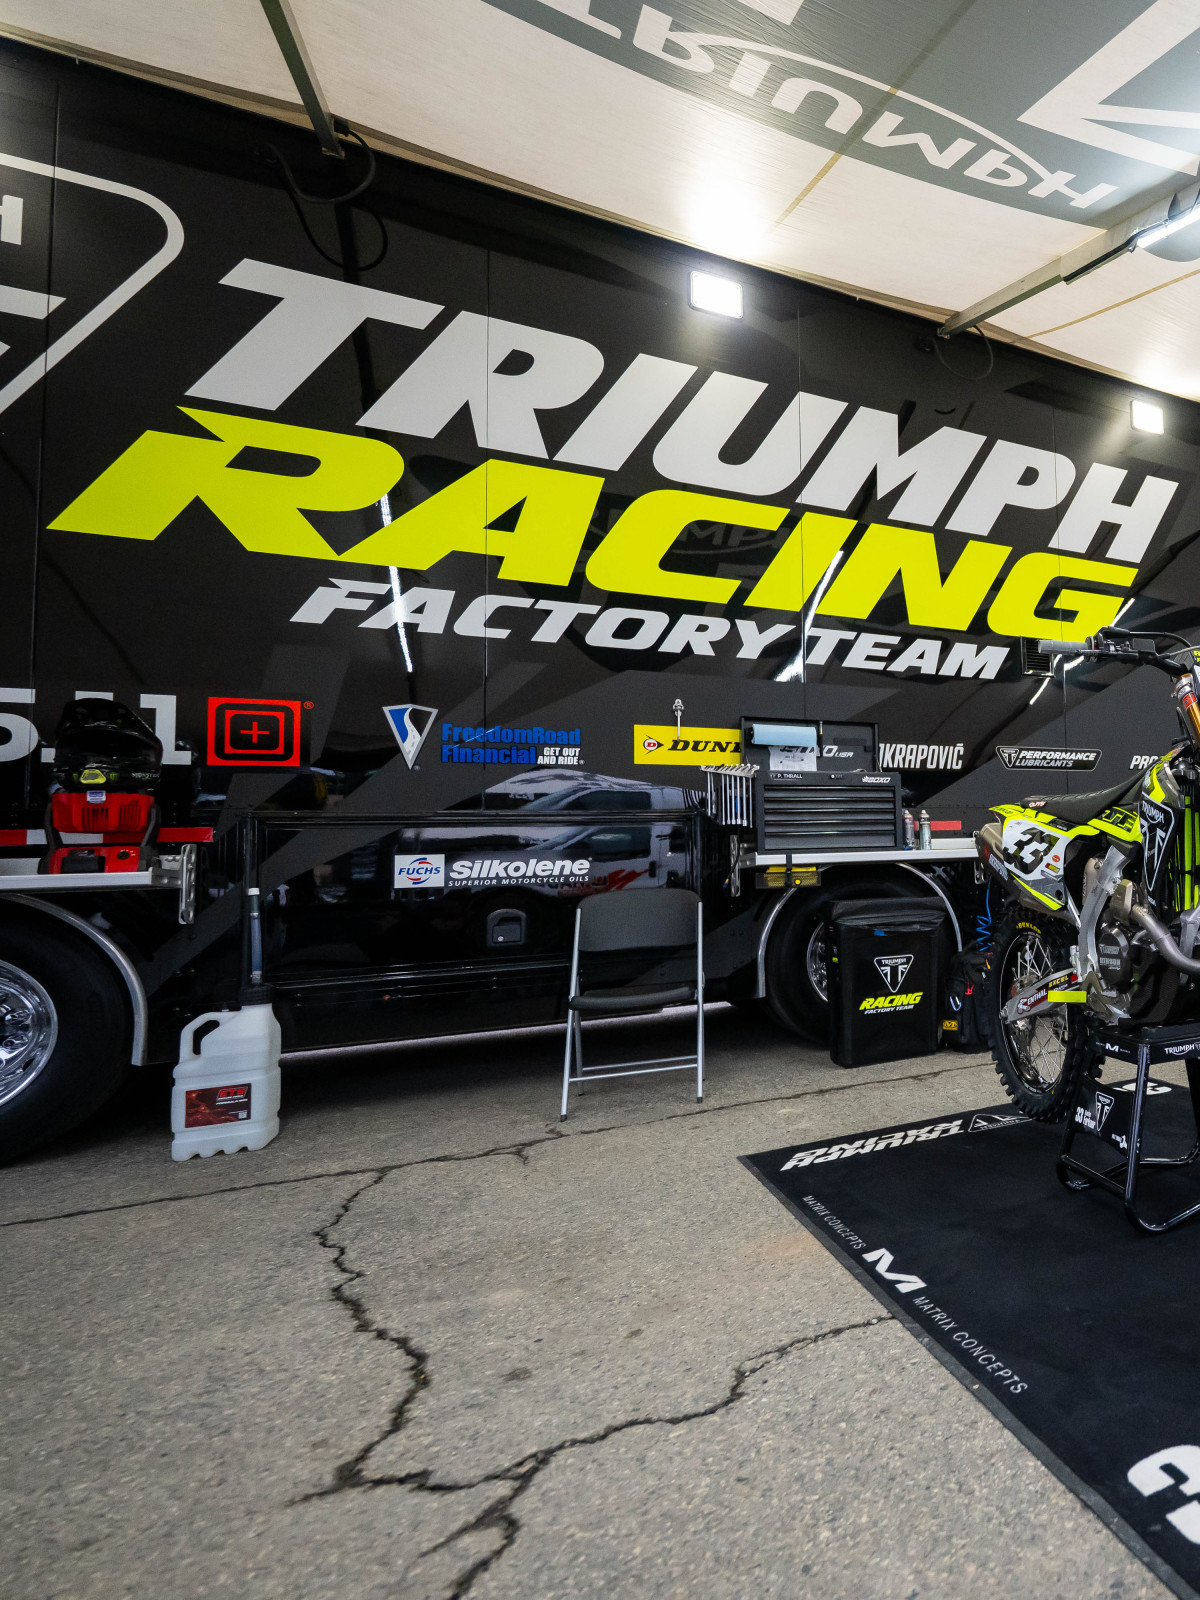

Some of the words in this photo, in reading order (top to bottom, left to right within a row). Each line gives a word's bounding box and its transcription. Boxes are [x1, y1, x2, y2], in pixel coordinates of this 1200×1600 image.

[184, 258, 1178, 562] TRIUMPH
[47, 406, 1138, 642] RACING
[290, 578, 792, 660] FACTORY
[778, 623, 1009, 681] TEAM
[442, 723, 581, 745] FreedomRoad
[441, 745, 536, 765] Financial
[543, 747, 560, 757] GET
[562, 747, 580, 757] OUT
[1019, 750, 1097, 761] PERFORMANCE
[537, 756, 556, 765] AND
[558, 756, 579, 765] RIDE
[1015, 758, 1074, 768] LUBRICANTS
[1142, 800, 1165, 824] TRIUMPH
[398, 865, 442, 876] FUCHS
[449, 858, 590, 879] Silkolene
[448, 879, 497, 887] SUPERIOR
[501, 876, 565, 885] MOTORCYCLE
[859, 992, 924, 1010] RACING
[864, 1006, 895, 1015] FACTORY
[1164, 1044, 1196, 1056] TRIUMPH
[219, 1088, 246, 1098] ETS
[803, 1195, 829, 1221] MATRIX
[824, 1215, 867, 1251] CONCEPTS
[911, 1296, 959, 1333] MATRIX
[951, 1331, 1029, 1395] CONCEPTS
